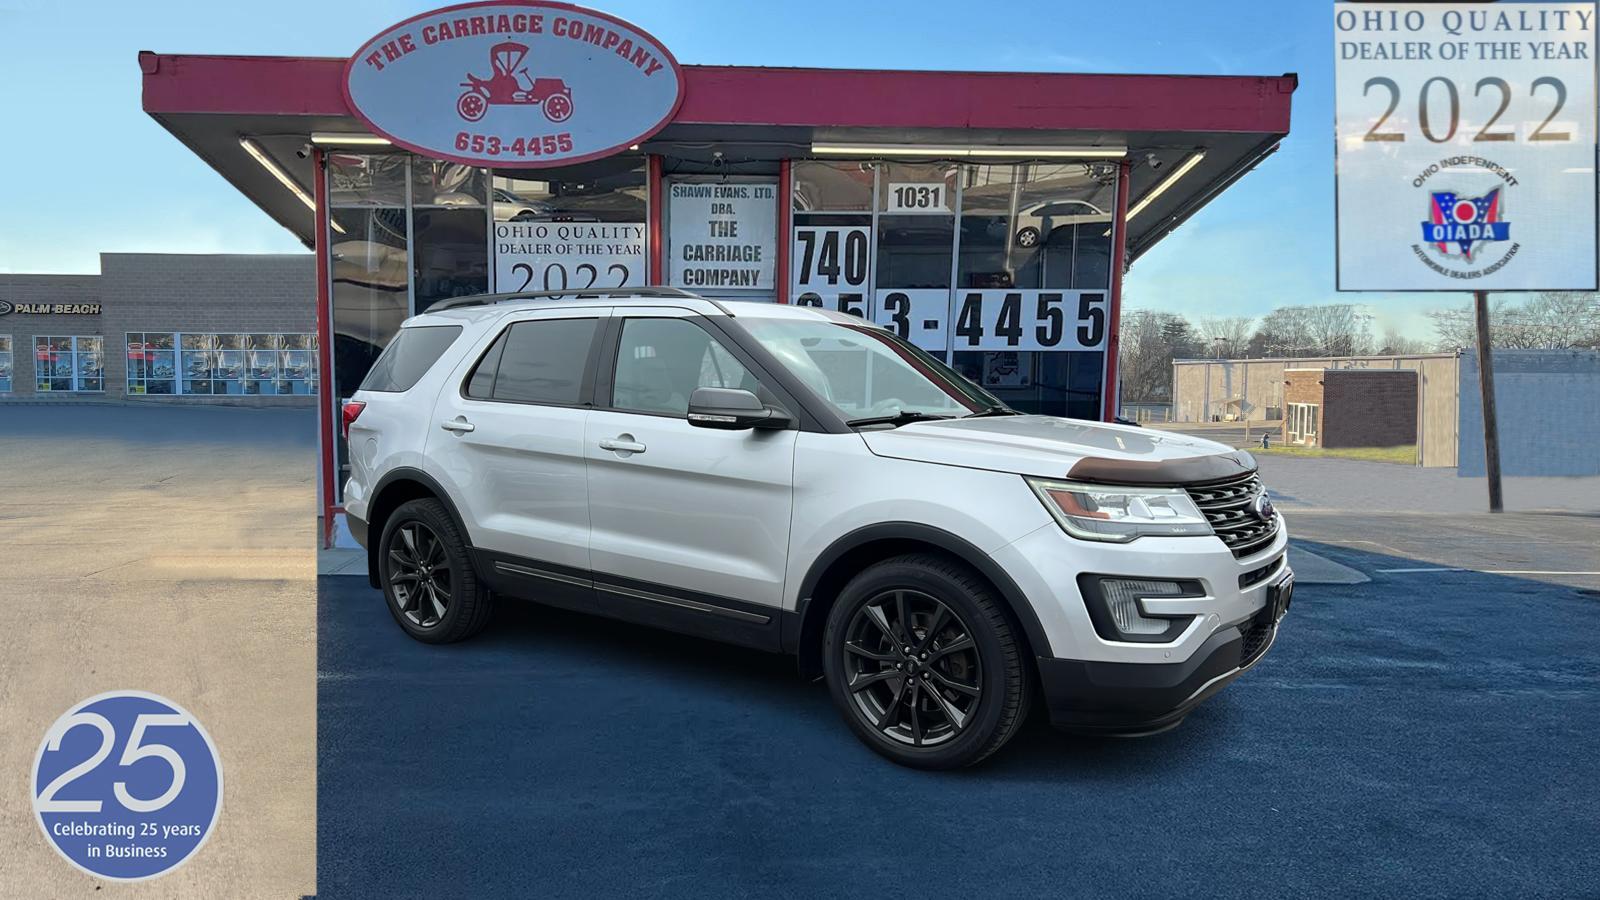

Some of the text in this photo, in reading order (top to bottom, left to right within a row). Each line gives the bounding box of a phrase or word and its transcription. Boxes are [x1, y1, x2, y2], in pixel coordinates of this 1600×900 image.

[1336, 10, 1593, 35] OHIO QUALITY
[365, 14, 664, 77] THE CARRIAGE COMPANY
[1340, 42, 1589, 60] DEALER OF THE YEAR
[1363, 76, 1571, 144] 2022
[454, 131, 574, 156] 653-4455
[1412, 155, 1519, 188] OHIO INDEPENDENT
[672, 186, 711, 199] SHAWN
[754, 187, 775, 200] LTD.
[894, 186, 941, 208] 1031
[711, 203, 736, 215] DBA.
[496, 225, 644, 241] OHIO QUALITY
[708, 220, 738, 238] THE
[1432, 224, 1495, 241] OIADA
[499, 243, 642, 256] DEALER OF THE YEAR
[682, 244, 762, 263] CARRIAGE
[797, 230, 868, 286] 740
[507, 262, 632, 300] 2022
[682, 268, 761, 287] COMPANY
[14, 304, 101, 314] PALM BEACH
[797, 292, 1106, 348] 3-4455
